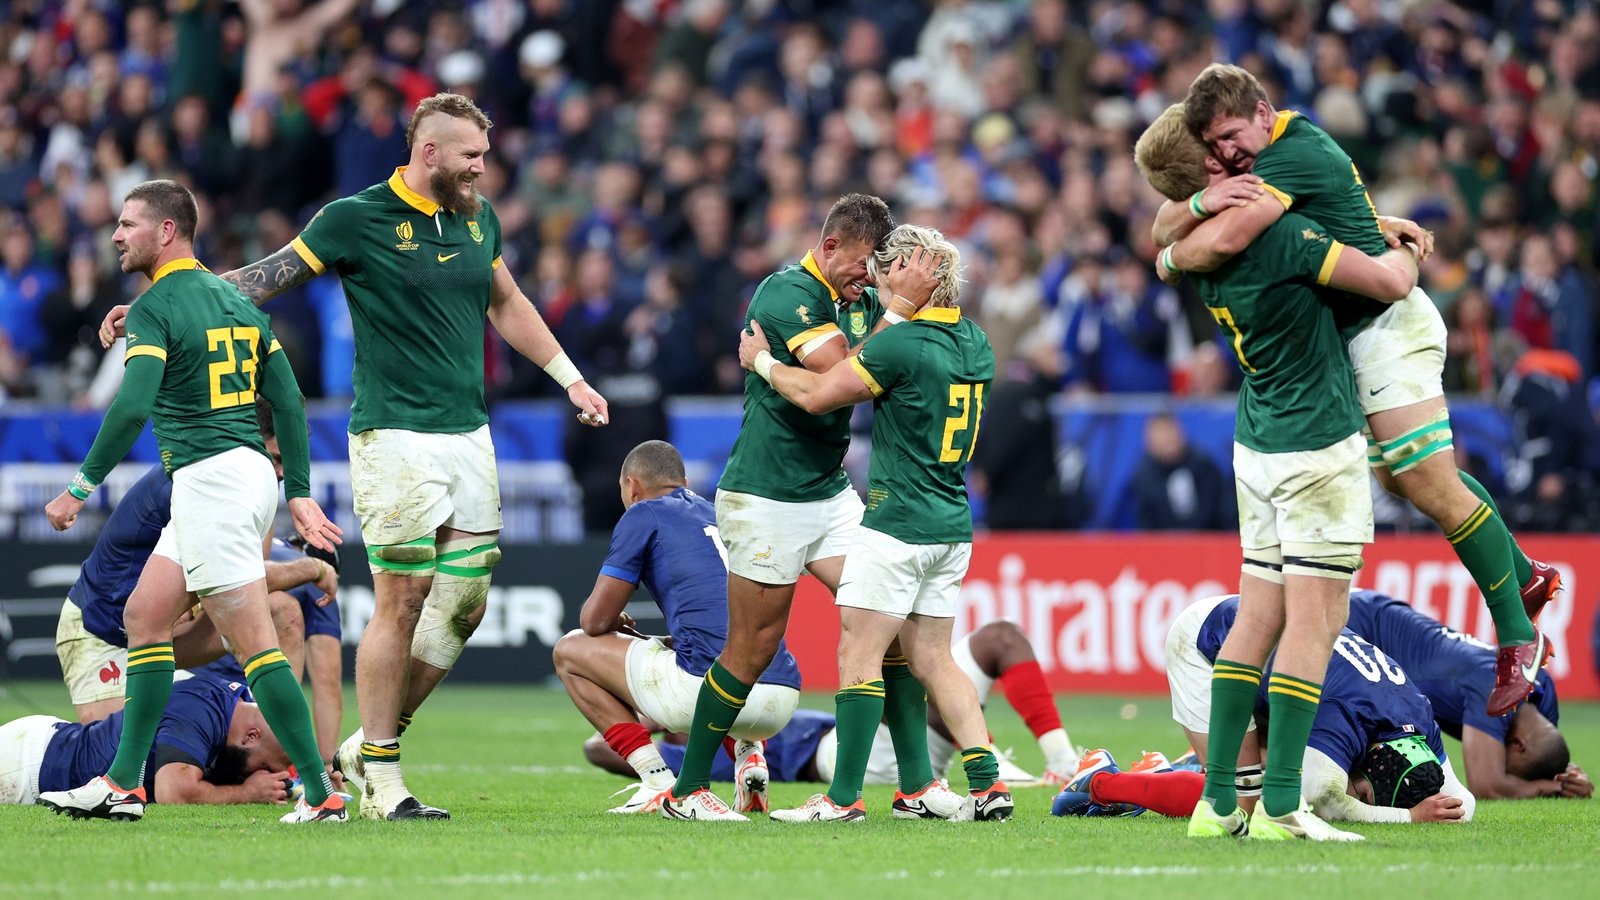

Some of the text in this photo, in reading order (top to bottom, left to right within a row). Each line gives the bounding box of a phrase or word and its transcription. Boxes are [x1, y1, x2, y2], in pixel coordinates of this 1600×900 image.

[206, 326, 260, 410] 23
[938, 383, 984, 463] 21
[949, 552, 1229, 675] irate
